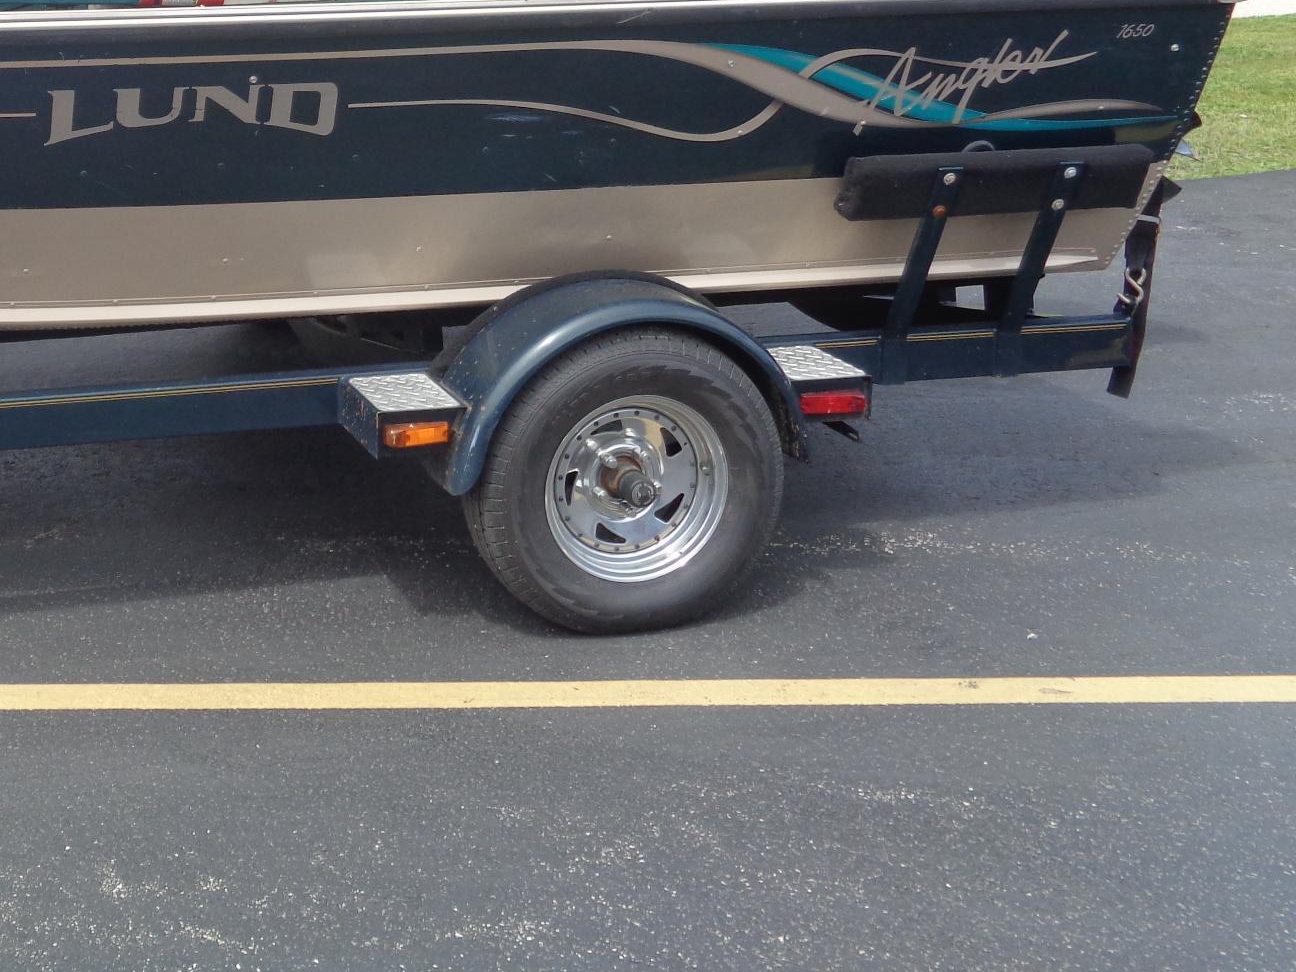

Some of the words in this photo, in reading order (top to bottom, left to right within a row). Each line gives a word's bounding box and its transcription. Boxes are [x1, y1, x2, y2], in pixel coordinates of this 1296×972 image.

[1116, 24, 1154, 38] 1650
[44, 82, 338, 146] LUND
[853, 29, 1072, 135] Angler
